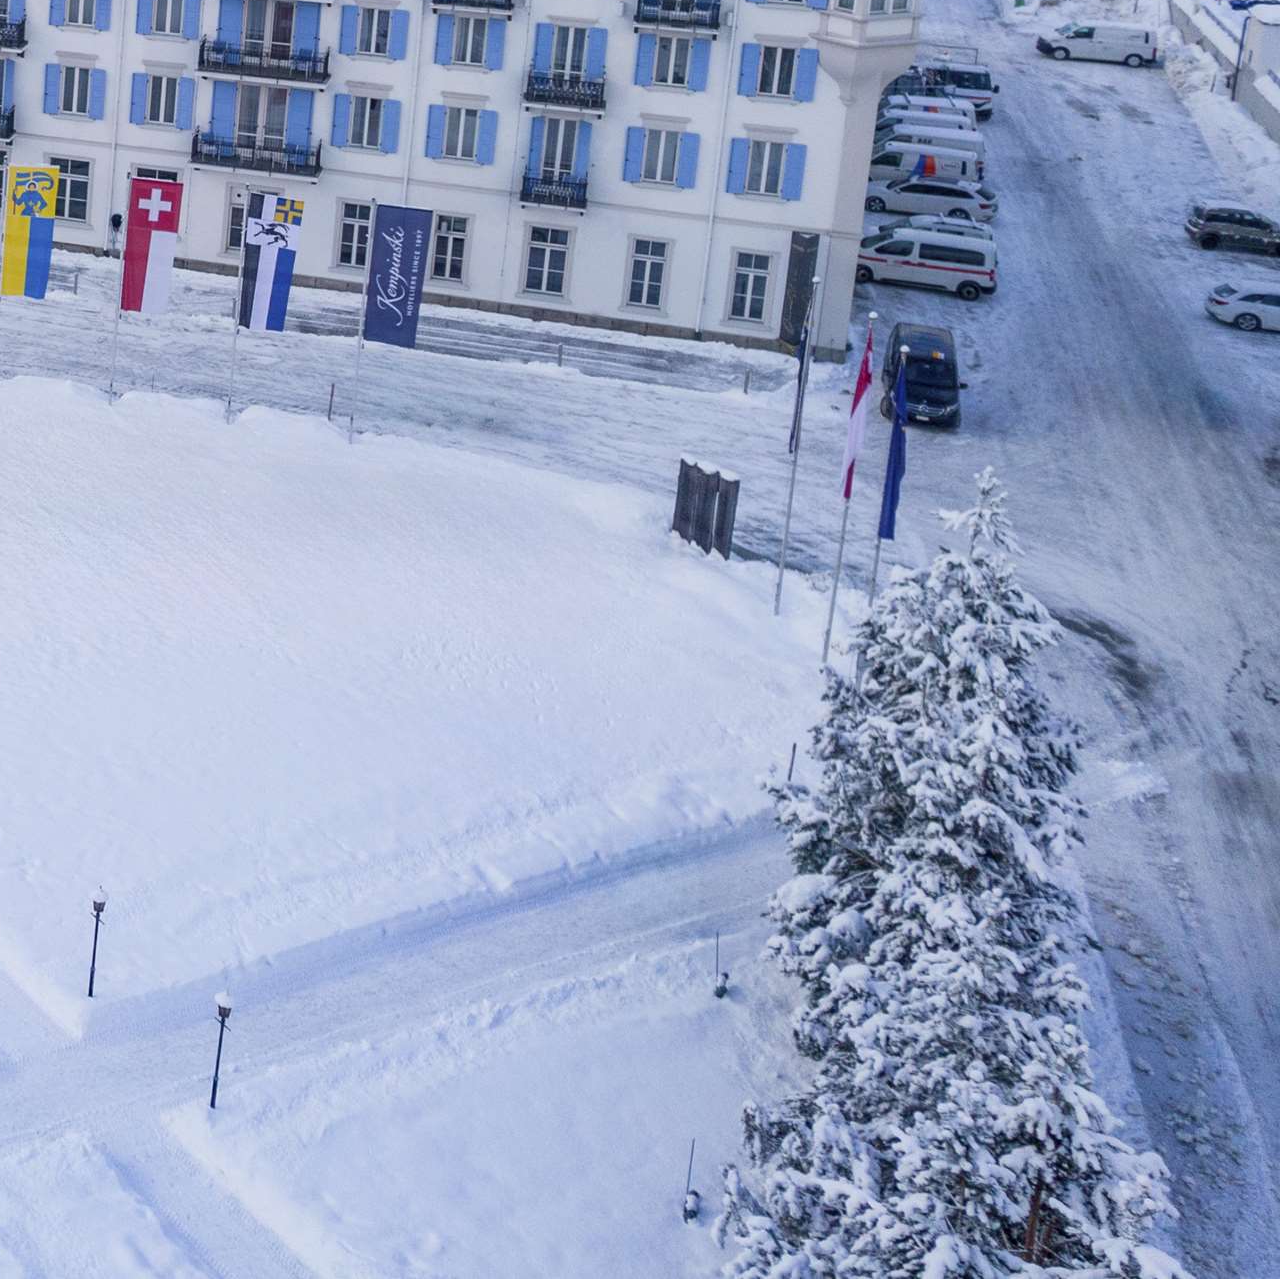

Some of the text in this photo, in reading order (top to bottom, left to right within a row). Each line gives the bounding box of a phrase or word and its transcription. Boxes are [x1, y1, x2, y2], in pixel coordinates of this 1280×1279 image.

[376, 226, 409, 326] Kempinski
[406, 276, 418, 316] HOTELIERS
[412, 251, 421, 273] SINCE
